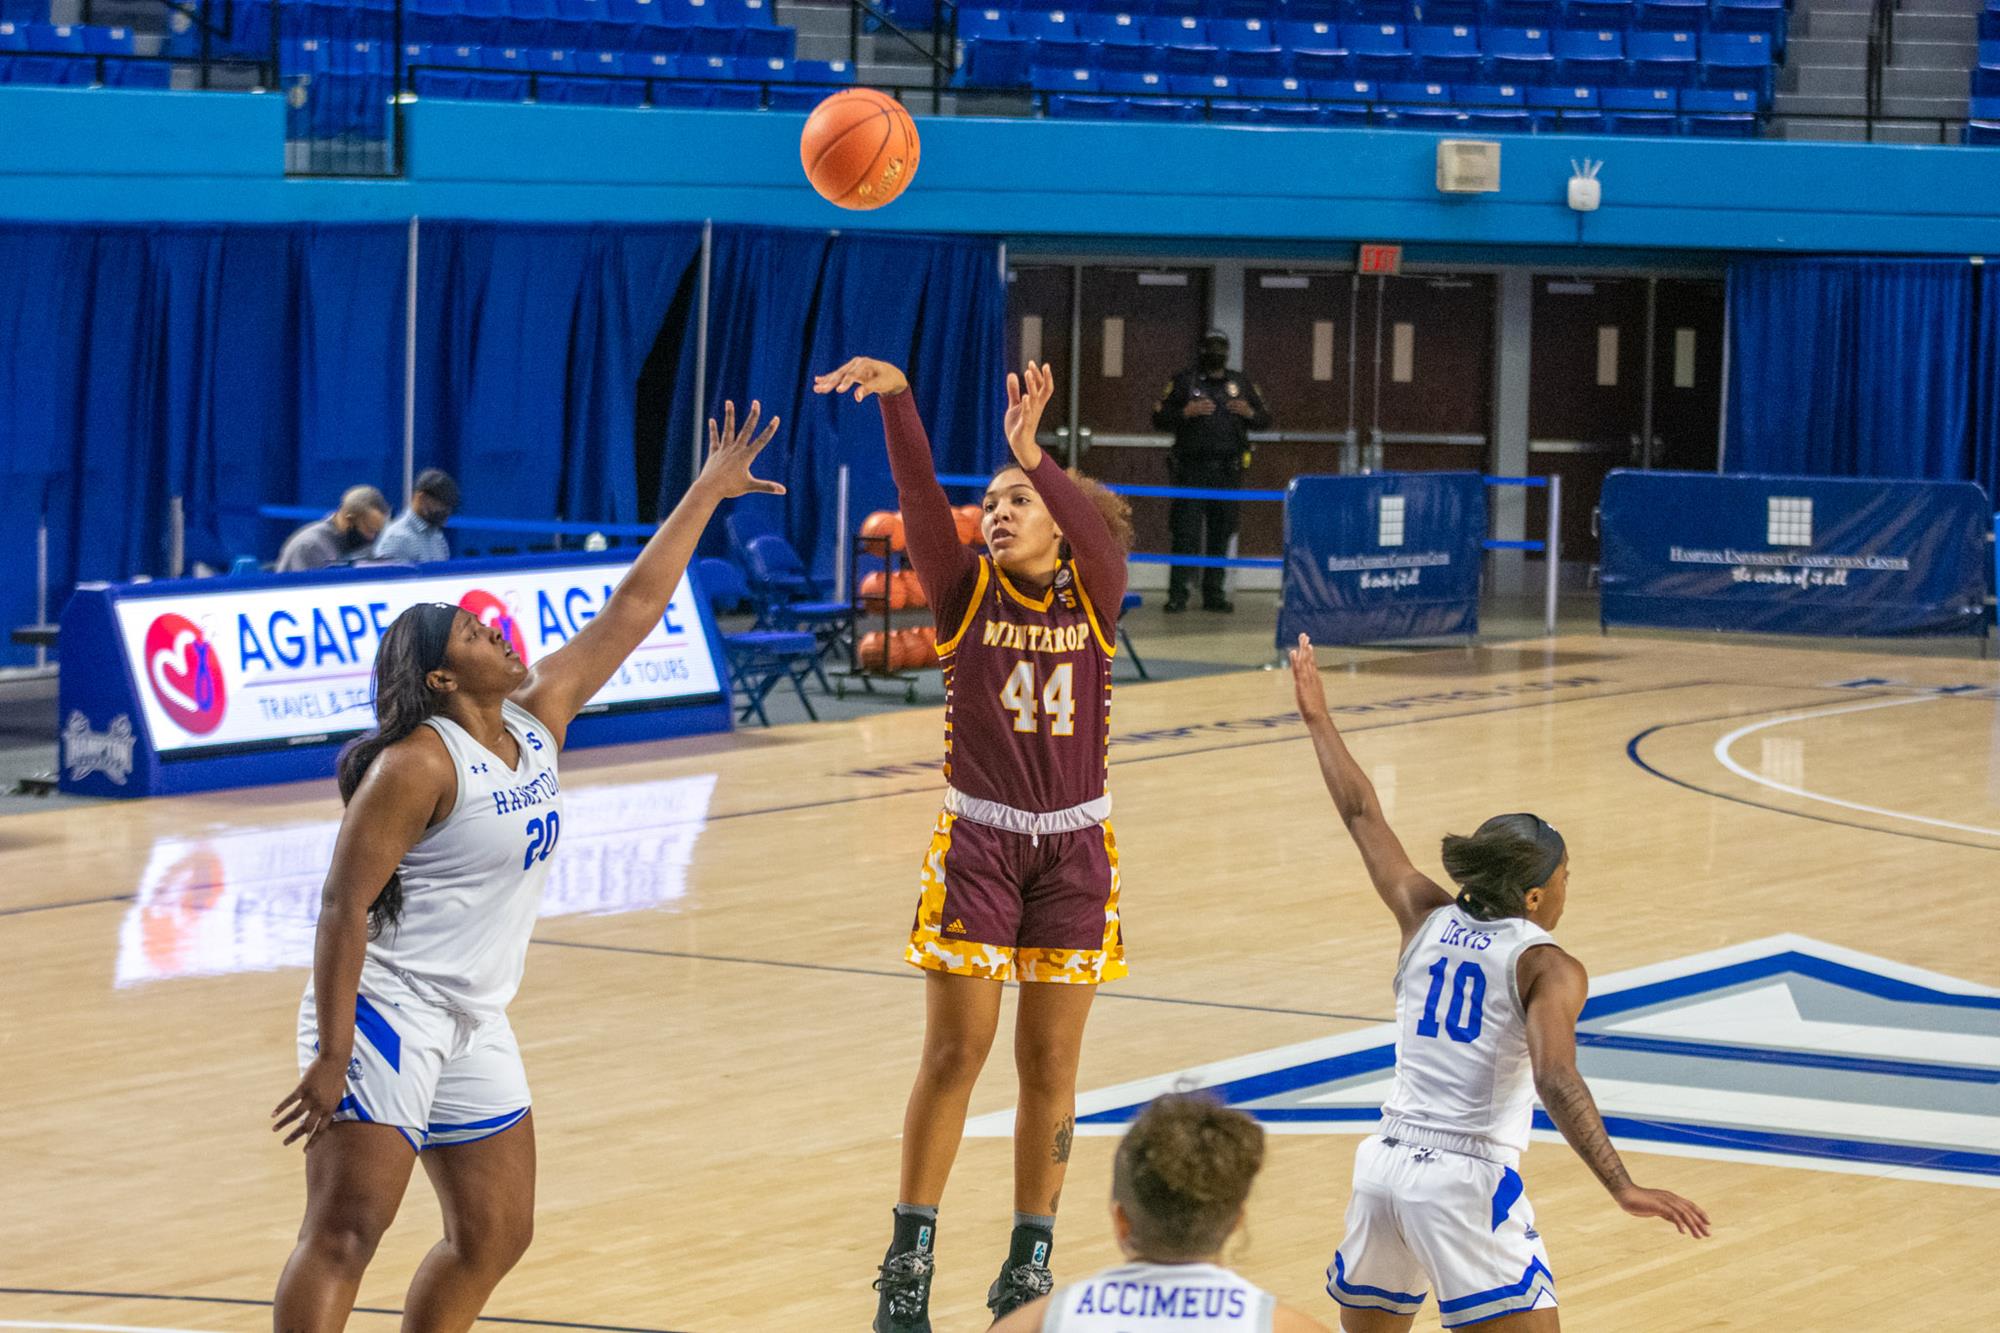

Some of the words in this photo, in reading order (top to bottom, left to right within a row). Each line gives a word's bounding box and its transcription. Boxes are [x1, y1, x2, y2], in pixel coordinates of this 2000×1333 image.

[1361, 246, 1398, 273] EXIT
[1670, 546, 1722, 564] HAMPTON
[1724, 548, 1785, 567] UNIVERSITY
[1787, 553, 1866, 570] CONVOCATION
[1867, 554, 1909, 571] CENTER
[982, 620, 1090, 653] WINTHROP
[634, 658, 690, 684] TOURS
[258, 692, 325, 721] TRAVEL
[1000, 660, 1076, 736] 44
[523, 810, 560, 871] 20
[1439, 918, 1497, 951] DAVIS
[1416, 956, 1487, 1044] 10
[1075, 1281, 1248, 1319] ACCIMEUS
